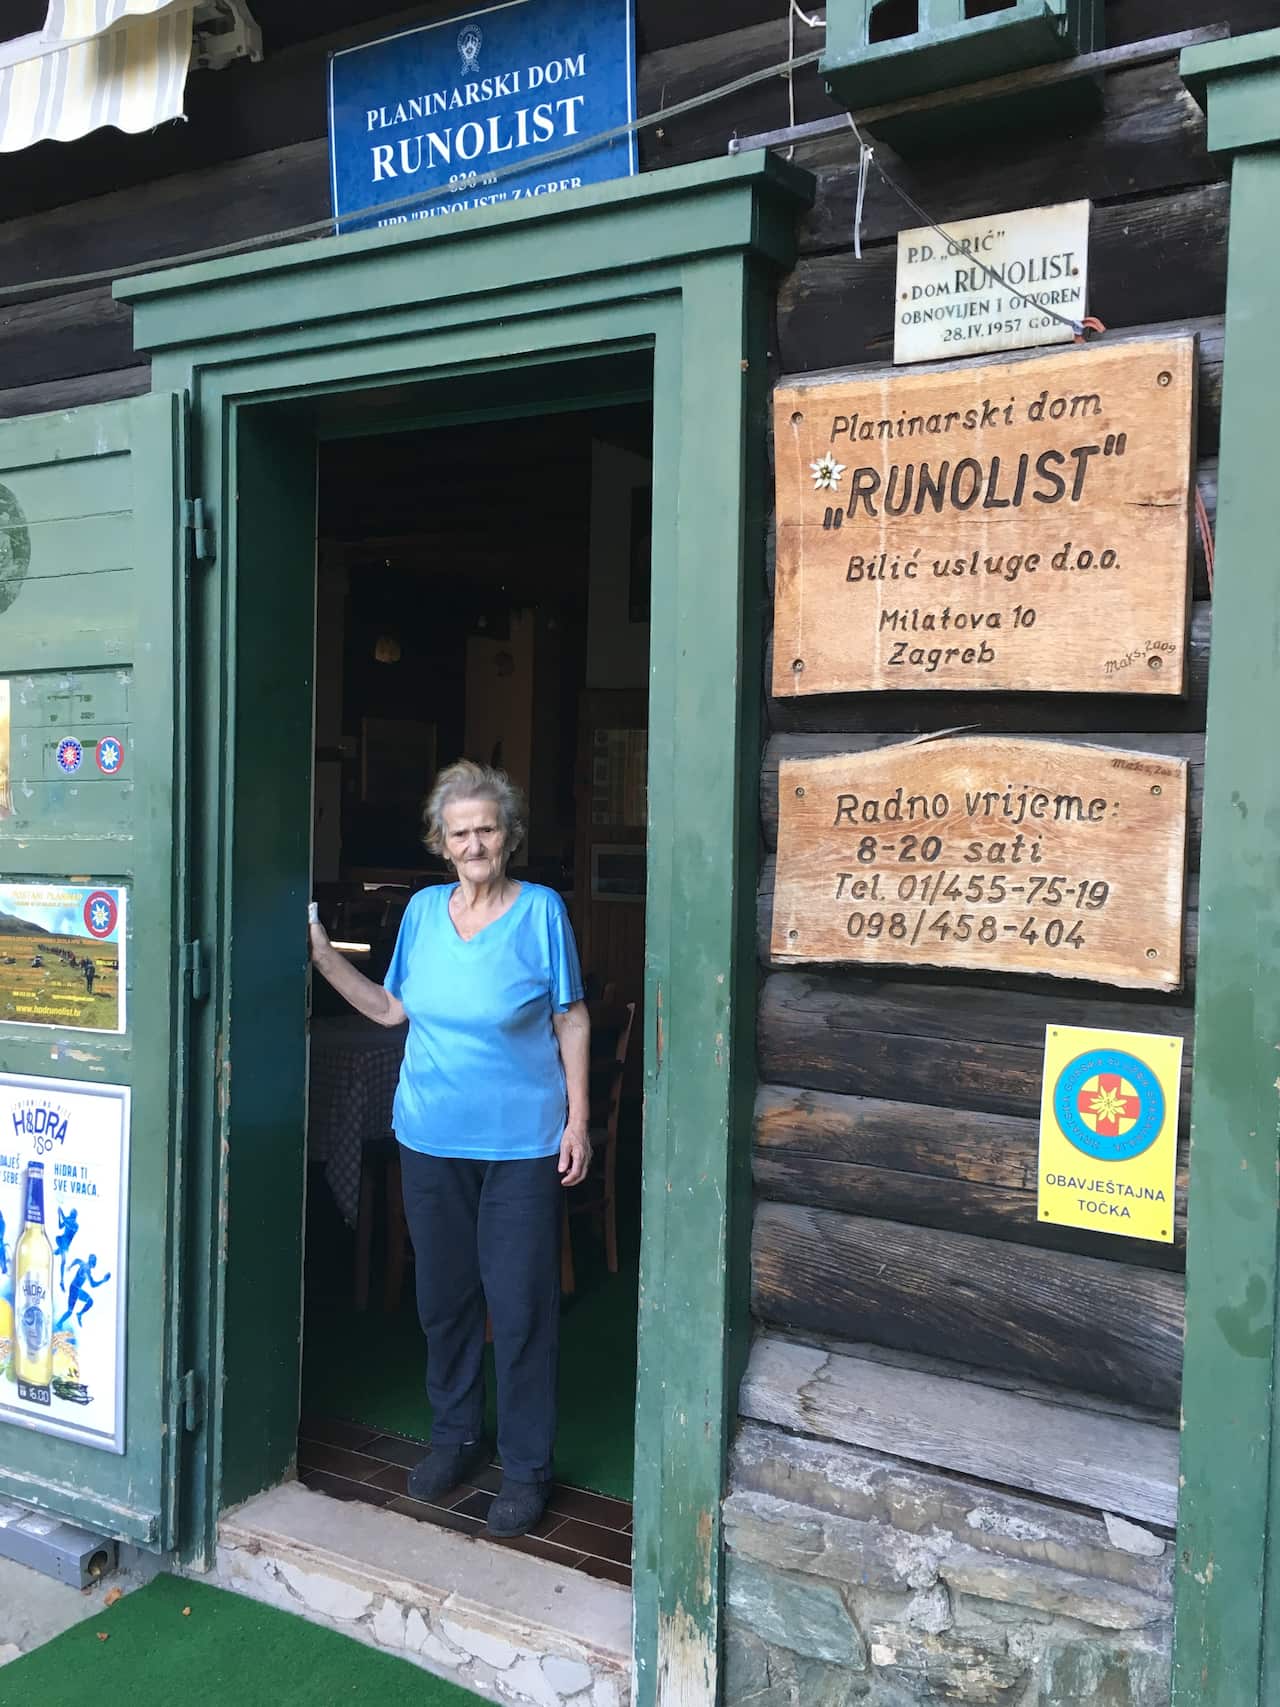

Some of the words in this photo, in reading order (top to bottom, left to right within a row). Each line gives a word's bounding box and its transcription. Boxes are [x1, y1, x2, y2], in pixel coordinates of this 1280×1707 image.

[366, 70, 520, 131] PLANINARSKI
[528, 53, 587, 90] DOM
[370, 95, 584, 183] RUNOLIST
[911, 281, 950, 301] DOM
[954, 252, 1075, 294] RUNOLIST
[901, 300, 990, 325] OBNOVLJEN
[996, 298, 1002, 313] I
[1009, 287, 1081, 310] OTVOREN
[830, 398, 1016, 444] Planinarski
[1027, 390, 1103, 421] dom
[846, 547, 921, 583] Bilić
[932, 549, 1041, 583] usluge
[1051, 541, 1122, 573] d.o.o.
[879, 606, 1002, 633] Milatova
[1013, 605, 1037, 630] 10
[886, 640, 996, 672] Zagreb
[834, 787, 950, 826] Radno
[964, 783, 1121, 826] vrijeme:
[855, 834, 943, 864] 8-20
[964, 834, 1043, 864] sati
[835, 872, 887, 902] Tel.
[897, 870, 1110, 910] 01/455-75-19
[846, 910, 1086, 949] 098/458-404
[53, 1179, 67, 1193] SVE
[1045, 1173, 1166, 1202] OBAVJEŠTAJNA
[1078, 1199, 1132, 1219] TOČKA
